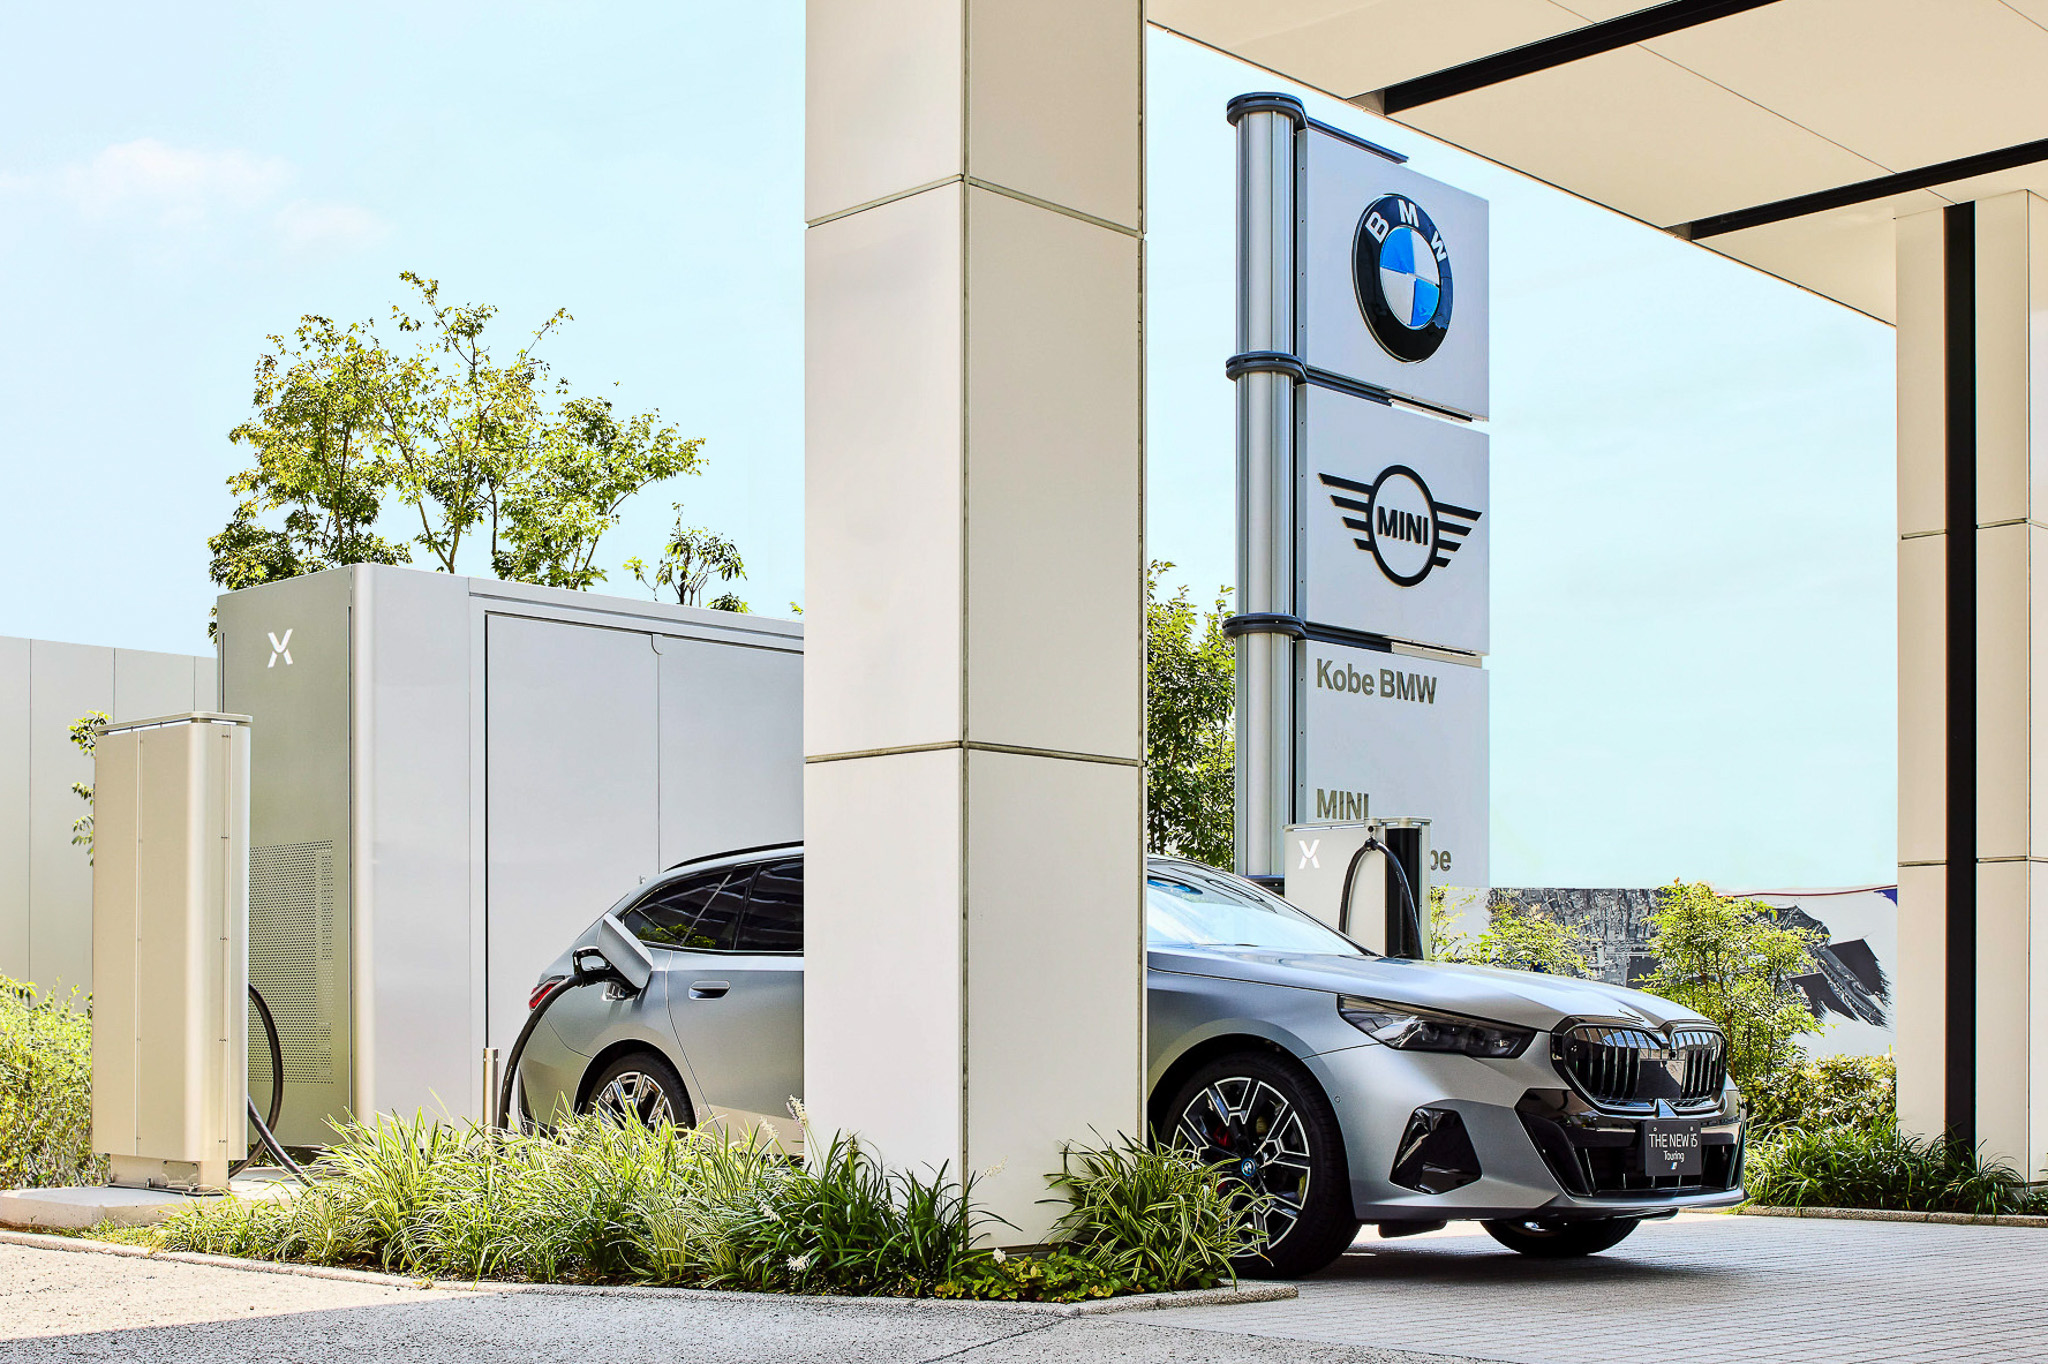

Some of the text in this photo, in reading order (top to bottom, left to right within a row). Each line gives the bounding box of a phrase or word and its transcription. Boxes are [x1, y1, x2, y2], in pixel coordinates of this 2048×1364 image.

[1364, 198, 1448, 263] BMW
[1377, 505, 1429, 546] MINI
[1317, 658, 1437, 704] Kobe BMW
[1316, 788, 1369, 821] MINI
[1648, 1133, 1669, 1148] THE
[1669, 1133, 1690, 1148] NEW
[1663, 1150, 1685, 1163] Touring
